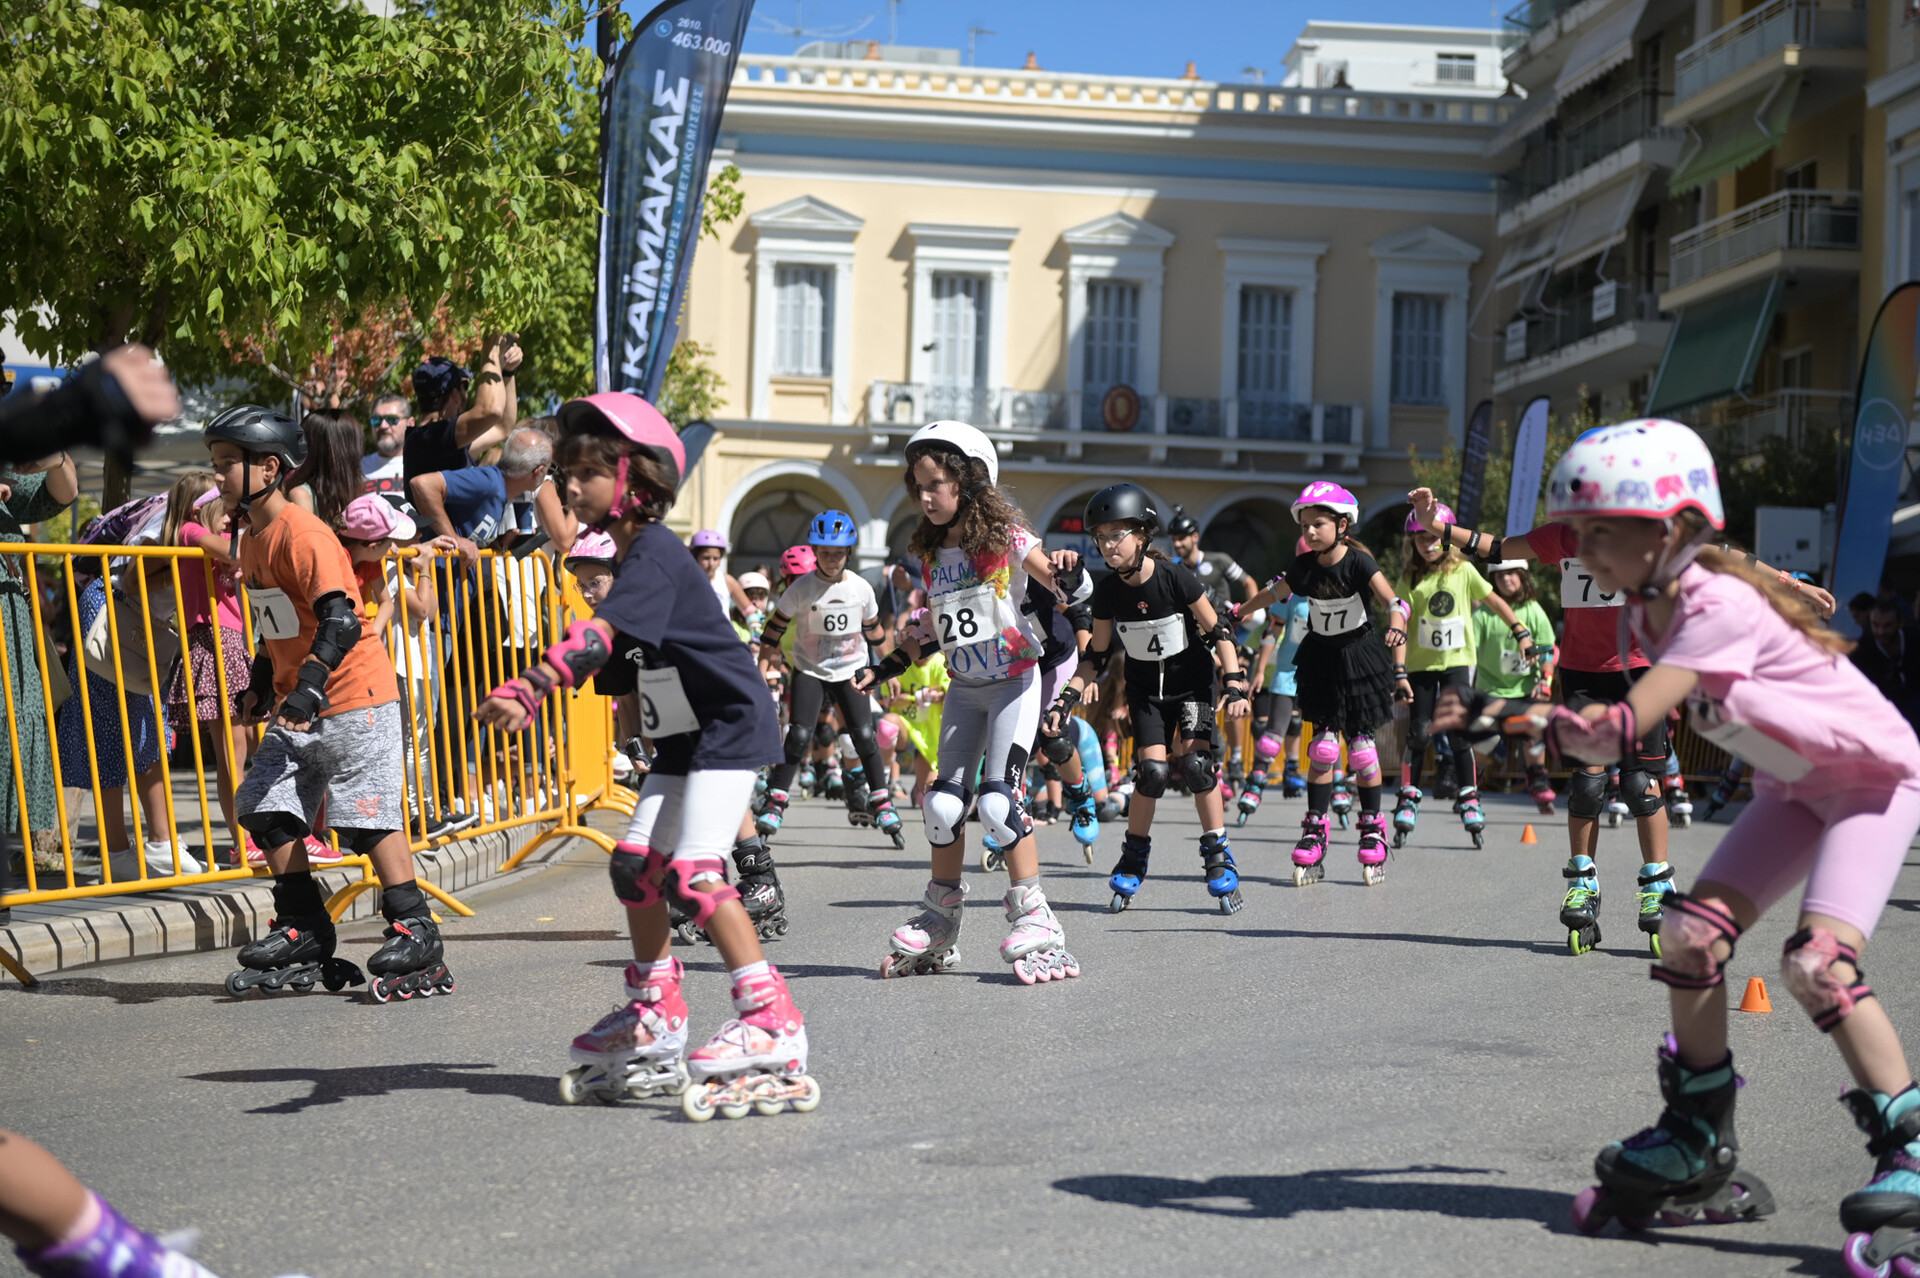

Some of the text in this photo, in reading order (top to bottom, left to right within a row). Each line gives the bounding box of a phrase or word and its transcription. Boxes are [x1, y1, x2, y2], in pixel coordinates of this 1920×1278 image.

[671, 31, 731, 56] 463.000
[620, 69, 690, 379] ΚΑΪΜΑΚΑΣ
[931, 561, 976, 588] PALM
[823, 613, 848, 632] 69
[938, 608, 979, 644] 28
[1320, 609, 1348, 632] 77
[1146, 633, 1165, 657] 4
[1431, 629, 1453, 647] 61
[945, 638, 1016, 674] OVE
